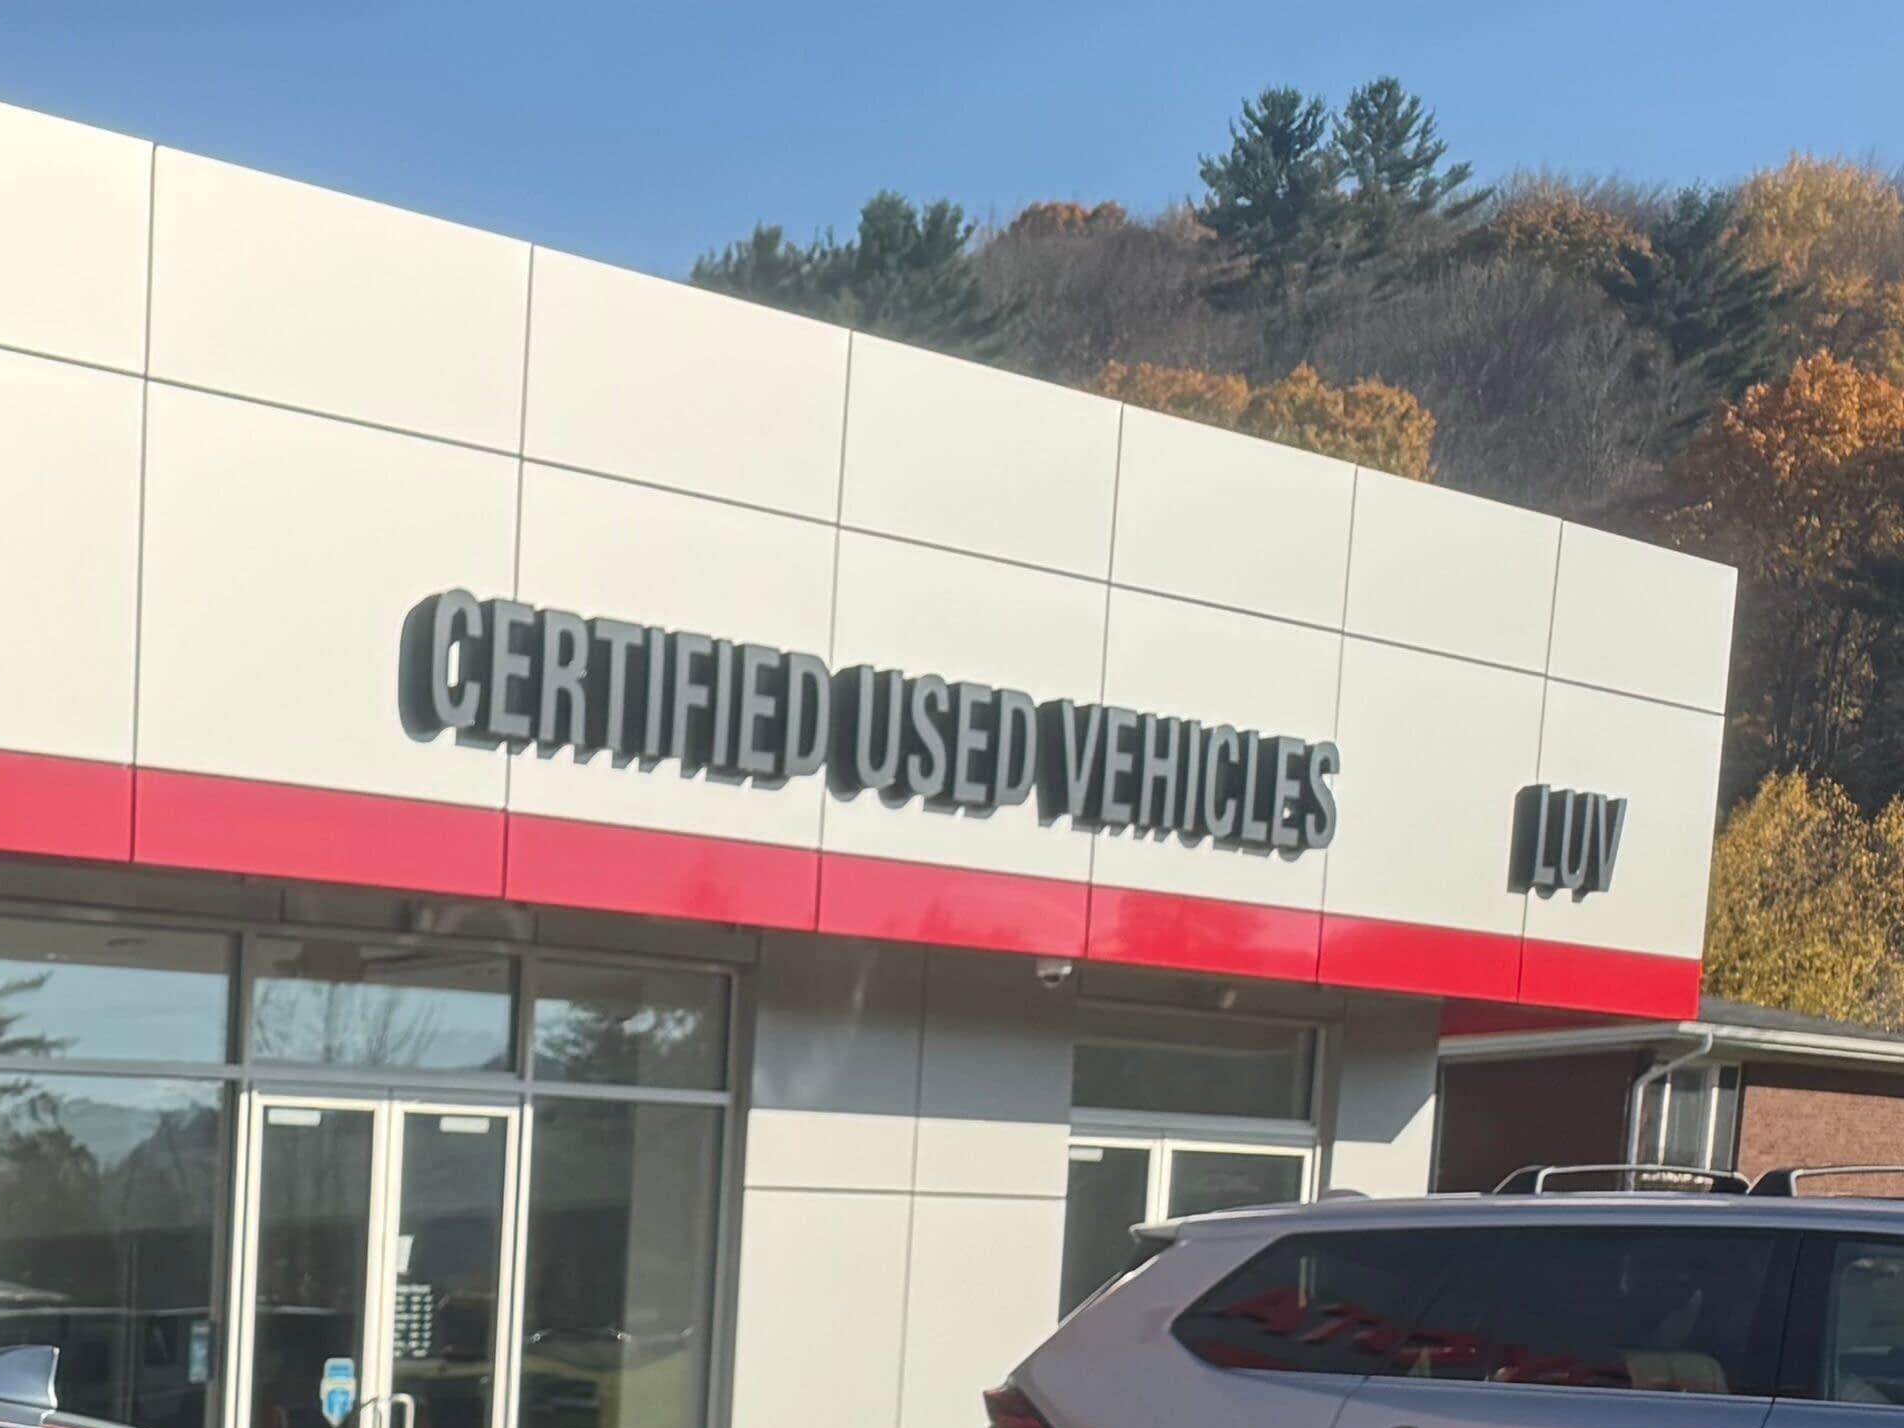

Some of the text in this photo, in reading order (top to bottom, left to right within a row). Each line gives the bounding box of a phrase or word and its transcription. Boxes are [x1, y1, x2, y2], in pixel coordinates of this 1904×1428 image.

[420, 588, 1341, 852] CERTIFIED USED VEHICLES
[1526, 784, 1628, 894] LUV
